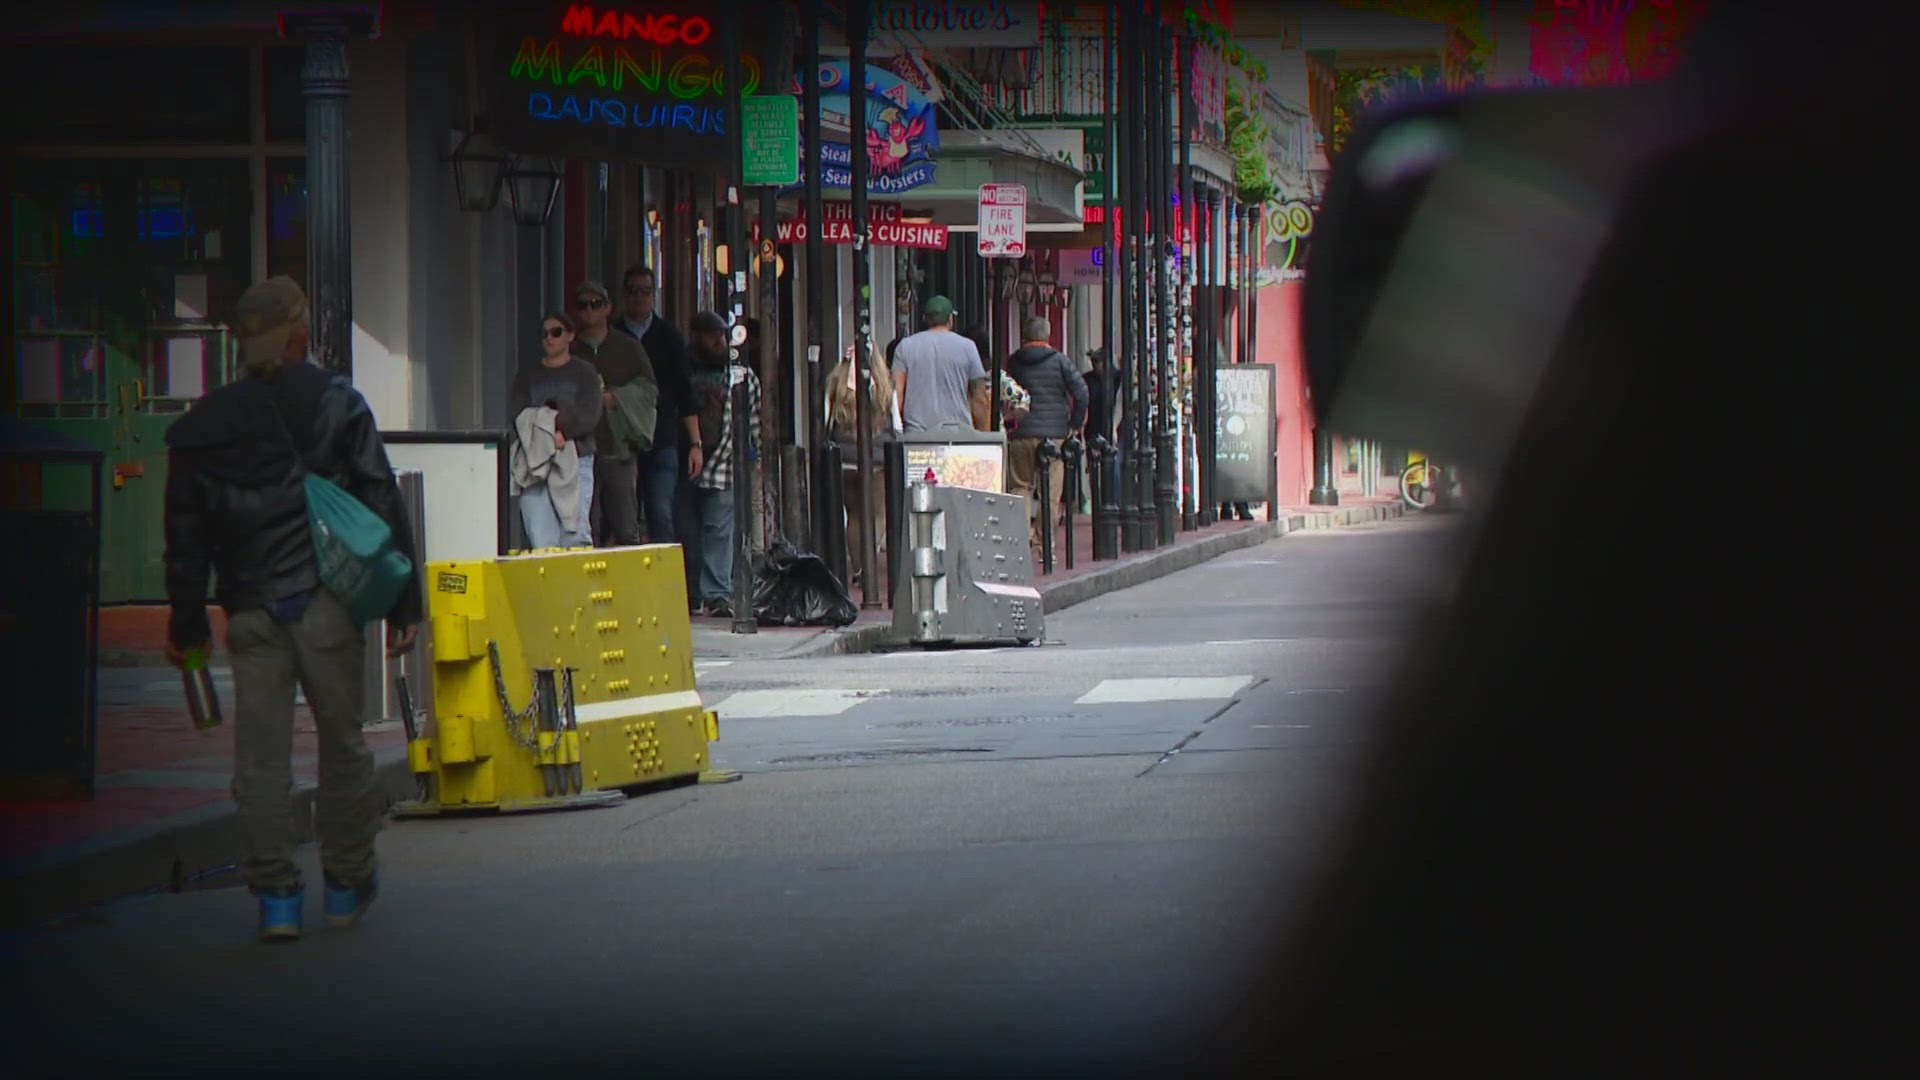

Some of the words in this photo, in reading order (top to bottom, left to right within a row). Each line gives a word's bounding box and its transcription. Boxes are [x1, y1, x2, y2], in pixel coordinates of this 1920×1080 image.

[562, 4, 711, 45] MANGO
[510, 36, 761, 99] MANGO
[879, 168, 926, 191] Oysters
[981, 188, 996, 203] NO
[990, 208, 1013, 221] FIRE
[877, 224, 943, 246] CUISINE
[987, 223, 1015, 236] LANE
